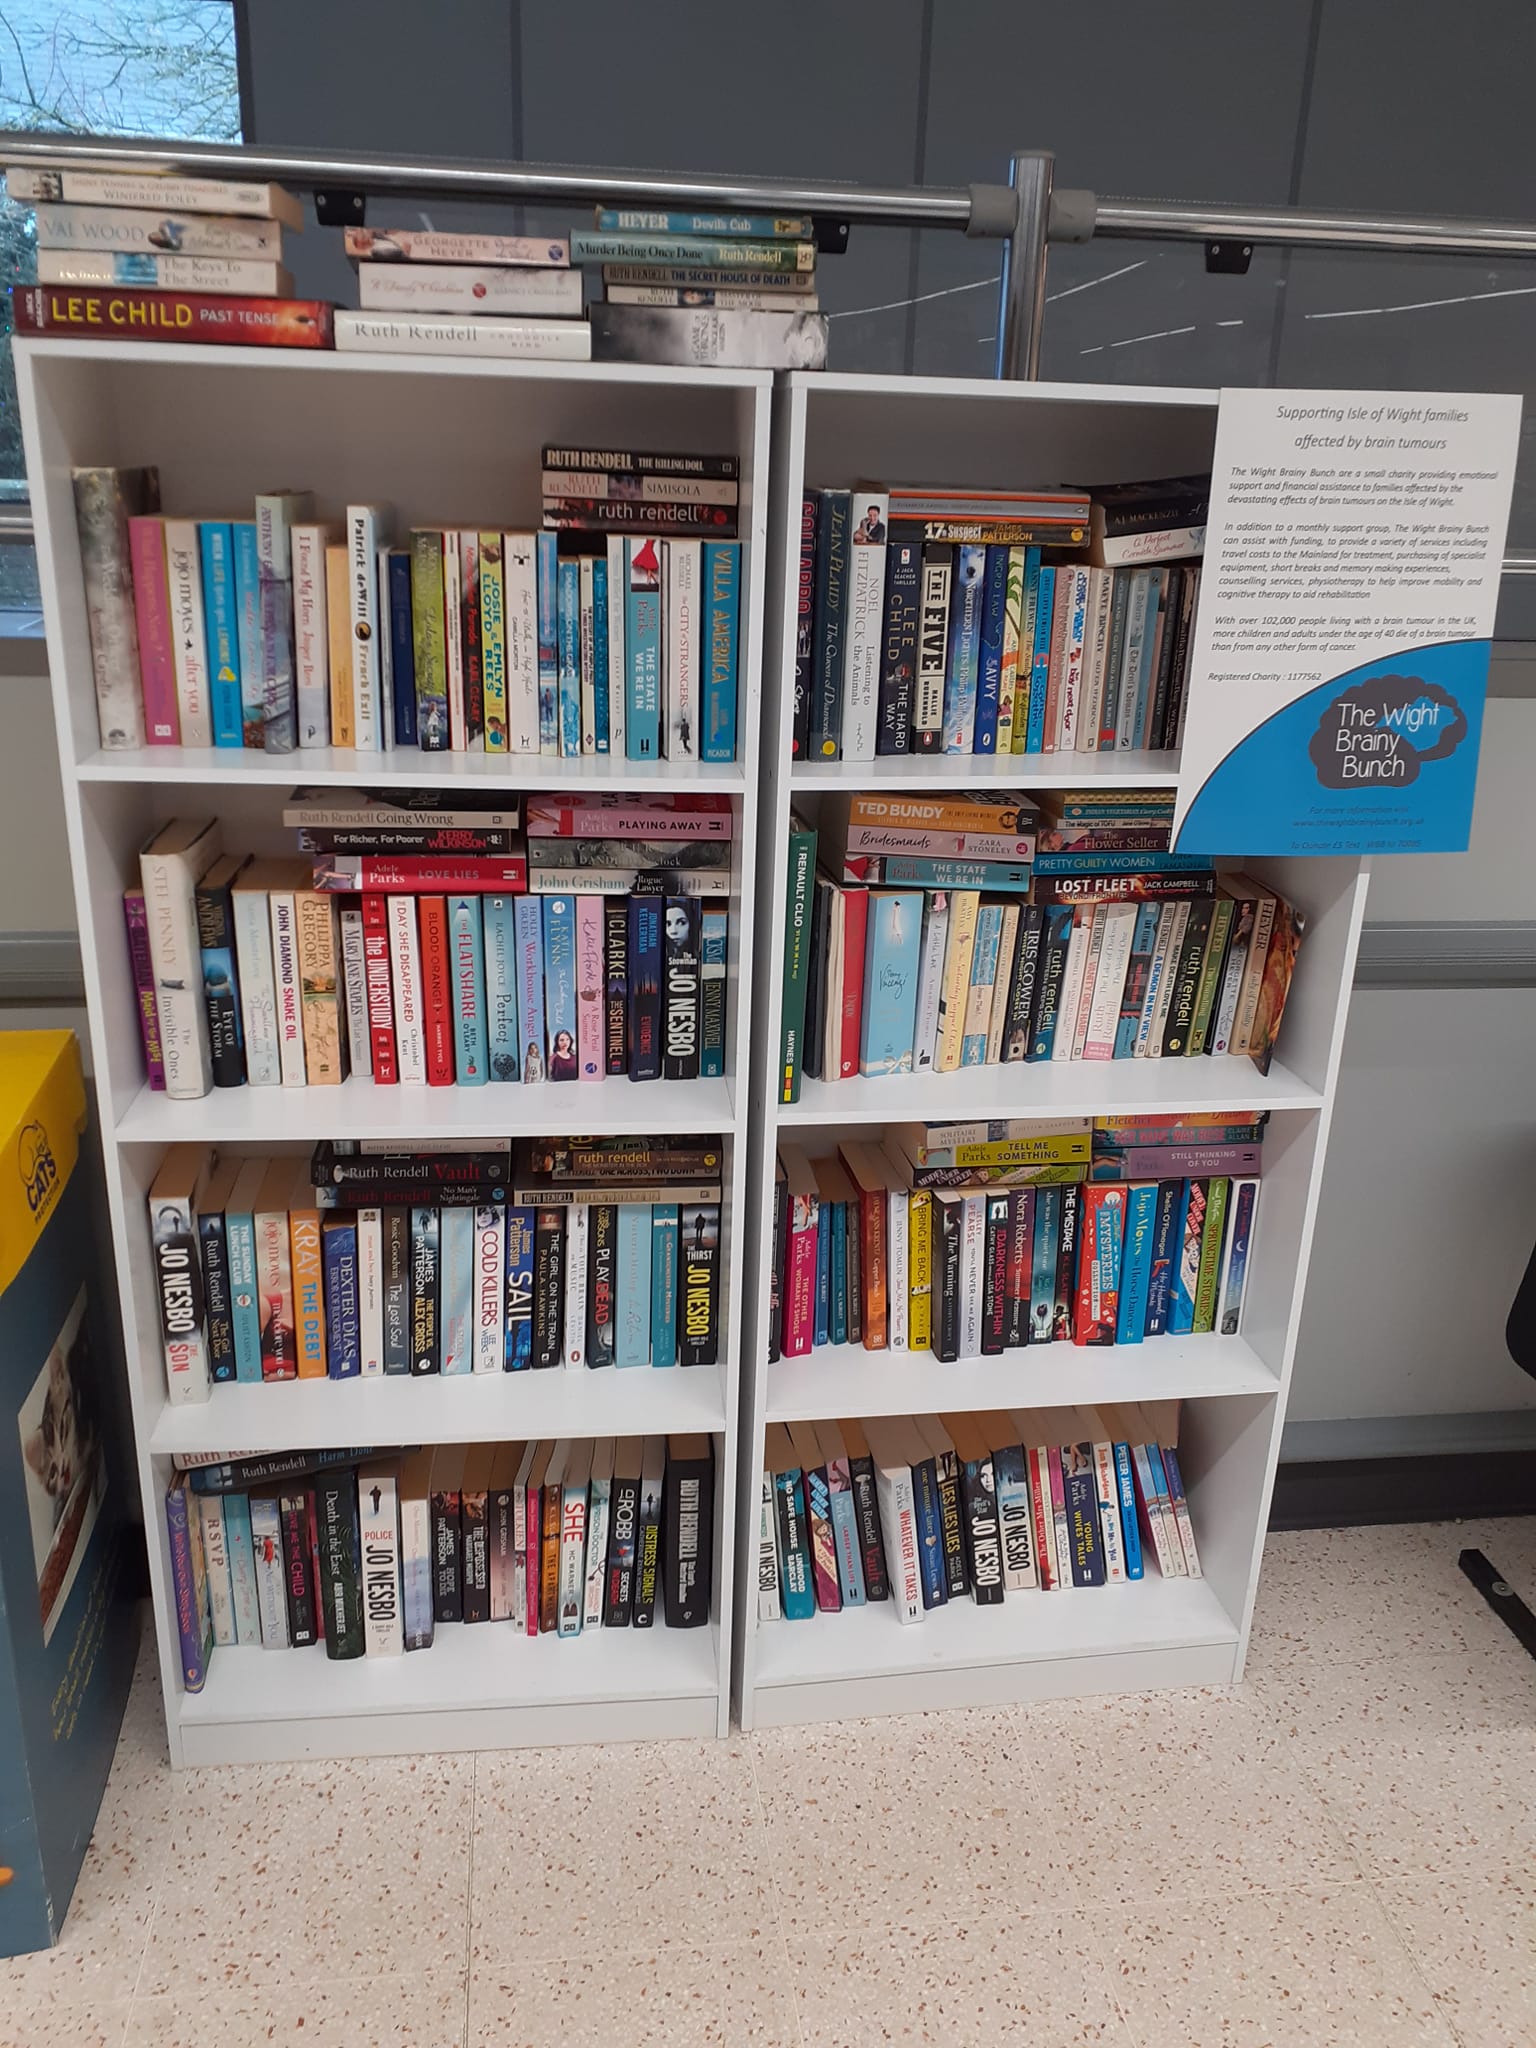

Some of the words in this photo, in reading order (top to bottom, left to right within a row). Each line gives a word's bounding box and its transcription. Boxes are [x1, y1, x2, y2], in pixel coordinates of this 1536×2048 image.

[52, 297, 101, 323] LEE
[108, 301, 193, 328] CHILD
[200, 309, 232, 322] PAST
[237, 310, 279, 324] TENSE
[355, 324, 400, 341] Ruth
[409, 325, 479, 343] Rendell
[1277, 406, 1344, 422] Supporting
[1347, 407, 1366, 420] Isle
[1371, 408, 1383, 423] of
[1386, 408, 1421, 423] Wight
[1422, 409, 1470, 424] families
[1295, 434, 1344, 448] affected
[1347, 435, 1360, 450] by
[1364, 436, 1395, 448] brain
[1399, 439, 1447, 449] tumours
[547, 450, 580, 468] RUTH
[581, 452, 633, 470] RENDELL
[1231, 467, 1246, 477] The
[1250, 468, 1276, 478] Wight
[1280, 468, 1306, 479] Brainy
[1310, 469, 1335, 478] Bunch
[1364, 470, 1385, 478] small
[1388, 470, 1416, 480] charity
[1419, 471, 1456, 481] providing
[1459, 471, 1498, 480] emotional
[598, 502, 633, 520] ruth
[639, 504, 698, 522] rendell
[355, 518, 366, 569] Patrick
[173, 548, 192, 581] jojo
[712, 549, 732, 603] VILLA
[356, 574, 368, 618] deWitt
[491, 576, 501, 625] JOSIE
[854, 551, 869, 641] FITZPATRICK
[868, 578, 879, 615] NOEL
[930, 570, 944, 602] THE
[1217, 589, 1256, 600] cognitive
[1259, 590, 1291, 601] therapy
[1292, 591, 1301, 599] to
[1303, 590, 1316, 599] aid
[1318, 590, 1371, 599] rehabilitation
[178, 583, 196, 634] moyes
[482, 573, 492, 633] LLOYD
[887, 595, 901, 661] CHILD
[901, 607, 915, 648] LEE
[922, 606, 946, 672] FIVE
[646, 646, 655, 673] THE
[711, 608, 731, 685] AMERICA
[852, 645, 864, 661] the
[185, 656, 203, 687] after
[359, 645, 369, 688] French
[485, 650, 494, 692] REES
[493, 642, 502, 699] EMLYN
[862, 646, 875, 692] Listening
[1208, 672, 1251, 682] Registered
[1253, 672, 1280, 682] Charity
[1287, 672, 1322, 682] 1177562
[184, 689, 201, 714] you
[646, 674, 655, 712] STATE
[851, 664, 863, 707] Animals
[863, 695, 873, 707] to
[896, 684, 909, 708] THE
[361, 690, 371, 721] Exit
[884, 703, 897, 731] WAY
[921, 681, 931, 726] RUBENHOLD
[929, 689, 939, 717] HALLIE
[1337, 703, 1376, 727] The
[1383, 702, 1440, 733] Wight
[894, 713, 907, 749] HARD
[1336, 730, 1400, 757] Brainy
[1342, 755, 1405, 779] Bunch
[618, 821, 669, 832] PLAYING
[671, 821, 702, 832] AWAY
[857, 803, 887, 816] TED
[889, 804, 945, 819] BUNDY
[794, 852, 808, 901] RENAULT
[1039, 858, 1072, 871] PRETTY
[1074, 857, 1106, 869] GUILTY
[1108, 856, 1155, 868] WOMEN
[1055, 878, 1091, 895] LOST
[1094, 878, 1137, 893] FLEET
[1143, 880, 1164, 890] JACK
[1165, 879, 1199, 890] CAMPBELL
[277, 904, 289, 933] JOHN
[397, 907, 408, 929] DAY
[794, 902, 805, 928] CLIO
[301, 899, 318, 971] GREGORY
[314, 902, 330, 969] PHILIPPA
[364, 936, 385, 957] the
[399, 931, 409, 952] SHE
[1025, 929, 1041, 959] IRIS
[280, 935, 293, 985] DIAMOND
[457, 933, 476, 1019] FLATSHARE
[524, 940, 537, 1004] Workhouse
[367, 958, 392, 1031] UNDERSTUDY
[400, 953, 414, 1023] DISAPPEARED
[668, 968, 697, 994] JO
[1017, 962, 1037, 1021] GOWER
[283, 987, 295, 1023] SNAKE
[285, 1025, 297, 1042] OIL
[524, 1006, 538, 1040] Angel
[667, 998, 697, 1058] NESBO
[786, 1029, 796, 1064] HAYNES
[26, 1151, 57, 1212] CATS
[917, 1207, 927, 1238] BRING
[1016, 1194, 1028, 1222] Nora
[159, 1243, 188, 1267] JO
[294, 1219, 319, 1277] KRAY
[481, 1231, 499, 1274] COLD
[551, 1234, 560, 1253] THE
[917, 1240, 926, 1256] ME
[947, 1234, 958, 1255] The
[1013, 1224, 1026, 1266] Roberts
[1100, 1218, 1114, 1290] MYSTERIES
[1204, 1223, 1219, 1277] SPRINGTIME
[549, 1256, 559, 1280] GIRL
[687, 1264, 711, 1285] JO
[917, 1257, 927, 1284] BACK
[943, 1255, 958, 1298] Warning
[162, 1273, 195, 1333] NESBO
[301, 1281, 318, 1314] THE
[480, 1276, 498, 1328] KILLERS
[508, 1271, 533, 1331] SAIL
[548, 1281, 558, 1297] ON
[1200, 1279, 1213, 1317] STORIES
[548, 1299, 557, 1318] THE
[685, 1288, 710, 1336] NESBO
[303, 1319, 320, 1362] DEBT
[547, 1320, 557, 1351] TRAIN
[168, 1344, 190, 1374] SON
[680, 1479, 699, 1512] RUTH
[564, 1503, 585, 1544] SHE
[971, 1516, 996, 1537] JO
[1002, 1504, 1026, 1522] JO
[644, 1525, 658, 1567] DISTRESS
[679, 1513, 699, 1561] RENDELL
[899, 1509, 914, 1561] WHATEVER
[1004, 1527, 1031, 1572] NESBO
[1084, 1521, 1094, 1554] YOUNG
[366, 1545, 394, 1565] JO
[904, 1562, 915, 1571] IT
[973, 1538, 1001, 1588] NESBO
[1076, 1542, 1086, 1567] TALES
[290, 1562, 305, 1597] CHILD
[367, 1570, 396, 1622] NESBO
[642, 1569, 655, 1605] SIGNALS
[905, 1573, 918, 1602] TAKES
